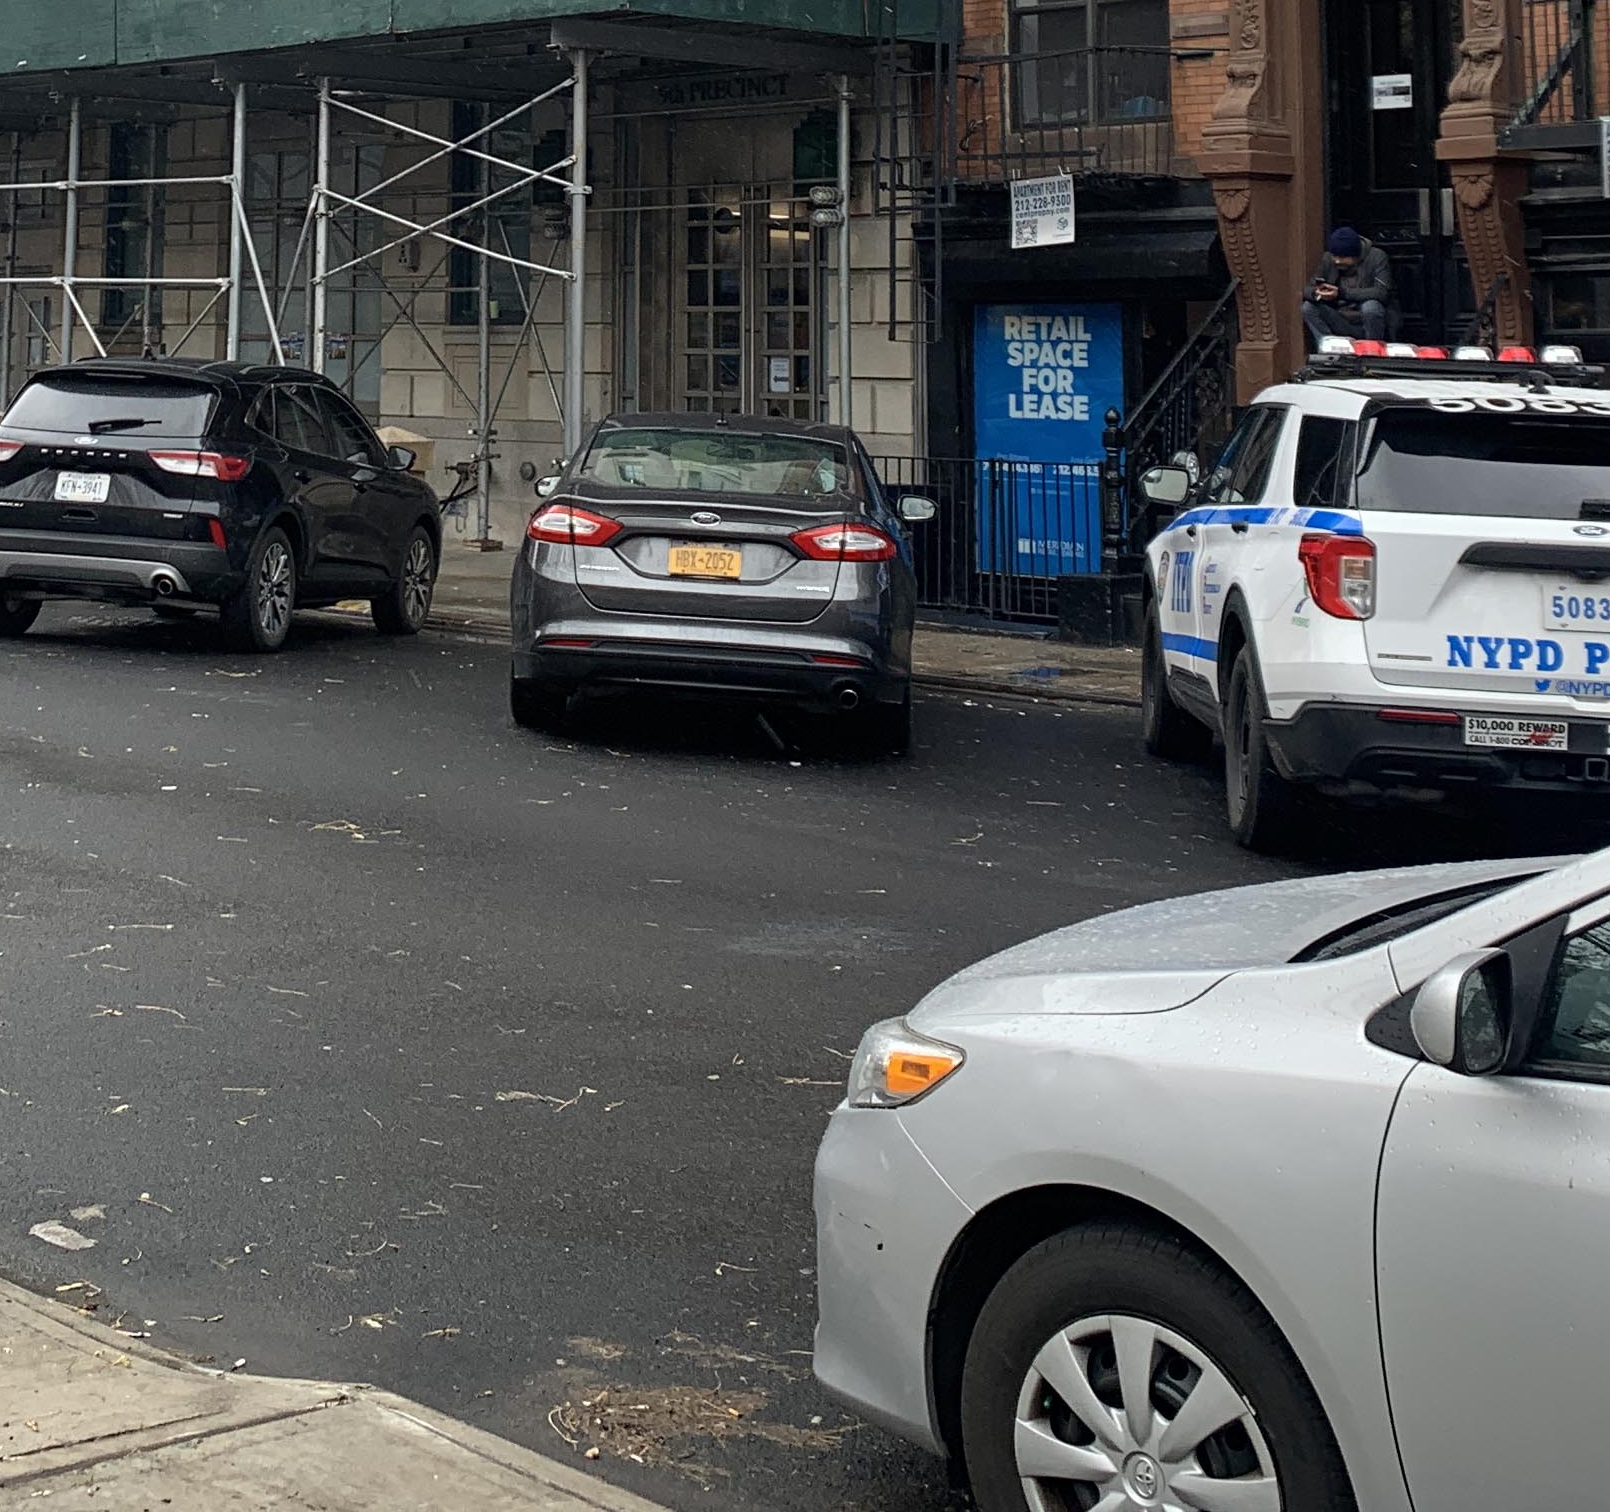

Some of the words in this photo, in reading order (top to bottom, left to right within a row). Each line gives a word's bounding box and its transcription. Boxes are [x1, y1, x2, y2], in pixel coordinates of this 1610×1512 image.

[1014, 194, 1071, 212] 212-228-9300
[1003, 314, 1093, 342] RETAIL
[1006, 341, 1090, 368] SPACE
[1022, 367, 1075, 394] FOR
[1008, 393, 1091, 422] LEASE
[675, 549, 734, 571] HBX-2052
[1552, 595, 1610, 622] 5083
[1446, 634, 1565, 672] NYPD
[1468, 719, 1514, 734] $10,000
[1518, 721, 1566, 735] REWARD
[1468, 733, 1487, 745] CALL
